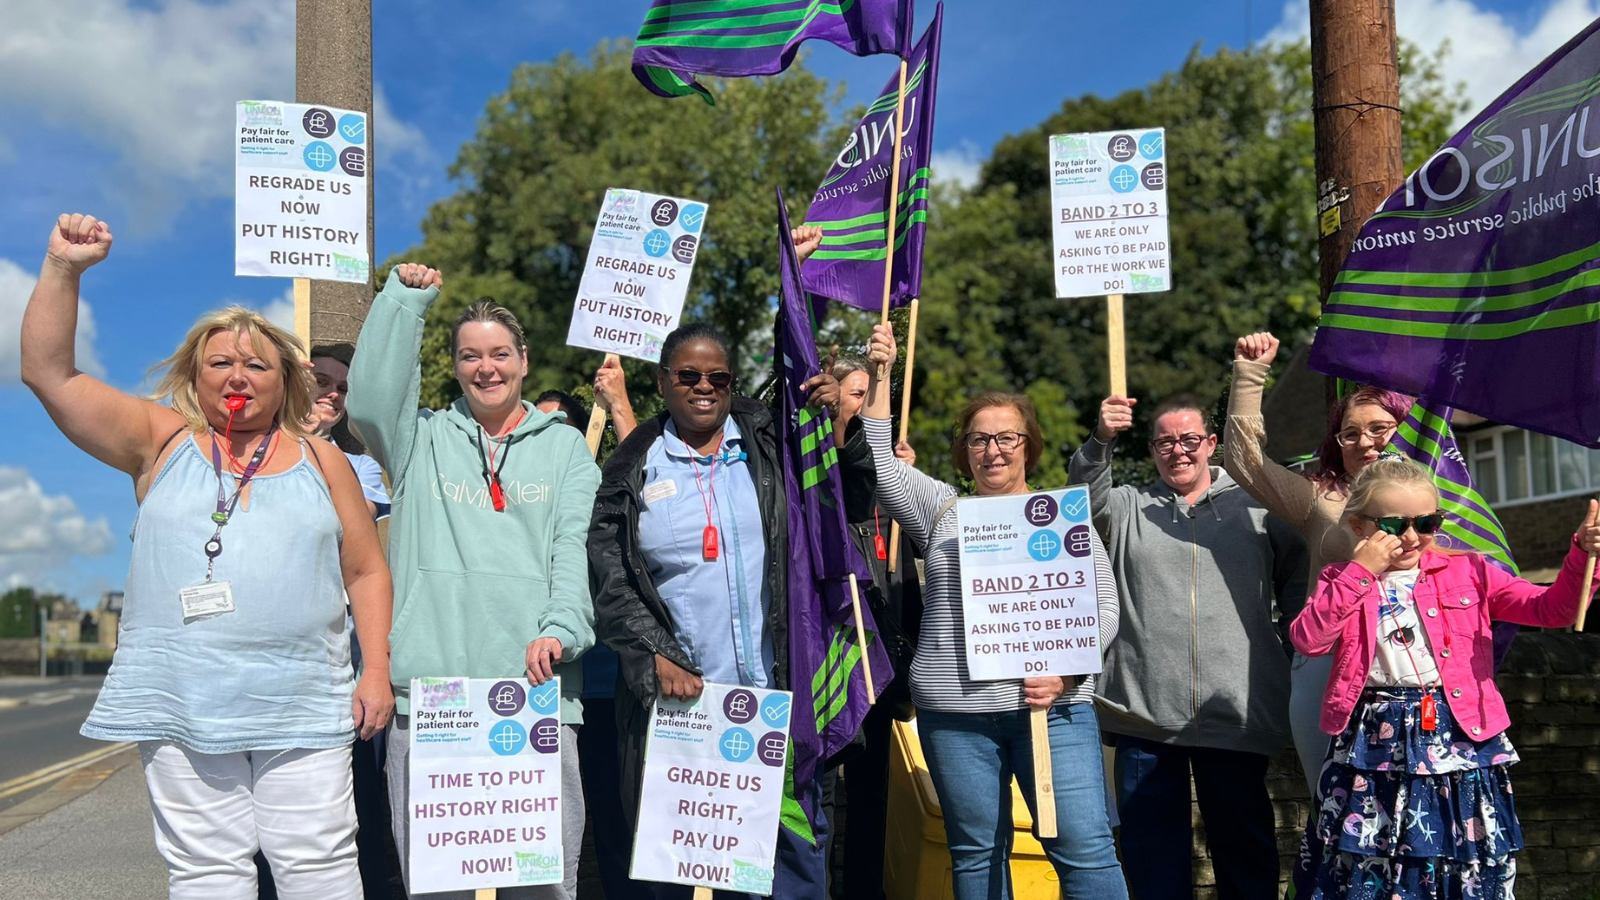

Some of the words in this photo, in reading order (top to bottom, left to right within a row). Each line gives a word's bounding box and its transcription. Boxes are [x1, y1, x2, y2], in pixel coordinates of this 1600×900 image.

[241, 128, 258, 136] Pay
[241, 136, 273, 144] patient
[1055, 160, 1069, 168] Pay
[1055, 167, 1083, 177] patient
[250, 176, 325, 192] REGRADE
[330, 181, 351, 195] US
[281, 201, 320, 215] NOW
[1061, 206, 1104, 220] BAND
[1110, 205, 1118, 217] 2
[1123, 203, 1144, 216] TO
[1149, 202, 1158, 214] 3
[242, 224, 277, 237] PUT
[282, 226, 359, 244] HISTORY
[1075, 229, 1092, 239] WE
[1094, 228, 1116, 238] ARE
[1119, 225, 1149, 236] ONLY
[1060, 246, 1101, 258] ASKING
[1104, 245, 1119, 254] TO
[1123, 243, 1136, 253] BE
[1140, 242, 1166, 252] PAID
[270, 251, 330, 267] RIGHT!
[1062, 265, 1084, 275] FOR
[1087, 264, 1108, 274] THE
[1112, 261, 1146, 273] WORK
[1149, 259, 1165, 269] WE
[595, 256, 654, 276] REGRADE
[657, 266, 676, 280] US
[613, 282, 646, 297] NOW
[1104, 280, 1124, 290] DO!
[579, 298, 606, 313] PUT
[609, 304, 672, 327] HISTORY
[594, 326, 642, 346] RIGHT!
[964, 526, 980, 534] Pay
[982, 524, 997, 532] fair
[964, 534, 996, 543] patient
[972, 577, 1023, 593] BAND
[1029, 575, 1039, 589] 2
[1044, 572, 1069, 586] TO
[1075, 571, 1085, 584] 3
[988, 604, 1008, 613] WE
[1012, 602, 1036, 612] ARE
[1040, 598, 1076, 610] ONLY
[972, 622, 1020, 634] ASKING
[1023, 621, 1041, 632] TO
[1045, 619, 1061, 630] BE
[1066, 616, 1095, 628] PAID
[974, 644, 1000, 654] FOR
[1004, 642, 1029, 653] THE
[1032, 639, 1074, 651] WORK
[1077, 636, 1096, 648] WE
[1024, 661, 1048, 672] DO!
[417, 711, 436, 720] Pay
[439, 710, 456, 718] fair
[459, 710, 473, 718] for
[657, 708, 675, 718] Pay
[677, 710, 692, 718] fair
[694, 712, 708, 720] for
[417, 721, 454, 731] patient
[656, 719, 689, 728] patient
[691, 723, 712, 731] care
[428, 773, 473, 789] TIME
[478, 771, 503, 787] TO
[509, 770, 545, 785] PUT
[667, 767, 731, 789] GRADE
[737, 775, 762, 792] US
[415, 801, 497, 819] HISTORY
[502, 797, 558, 814] RIGHT
[678, 799, 743, 826] RIGHT,
[428, 828, 516, 847] UPGRADE
[522, 826, 546, 841] US
[673, 830, 708, 848] PAY
[712, 835, 739, 851] UP
[462, 857, 512, 875] NOW!
[678, 862, 730, 883] NOW!
